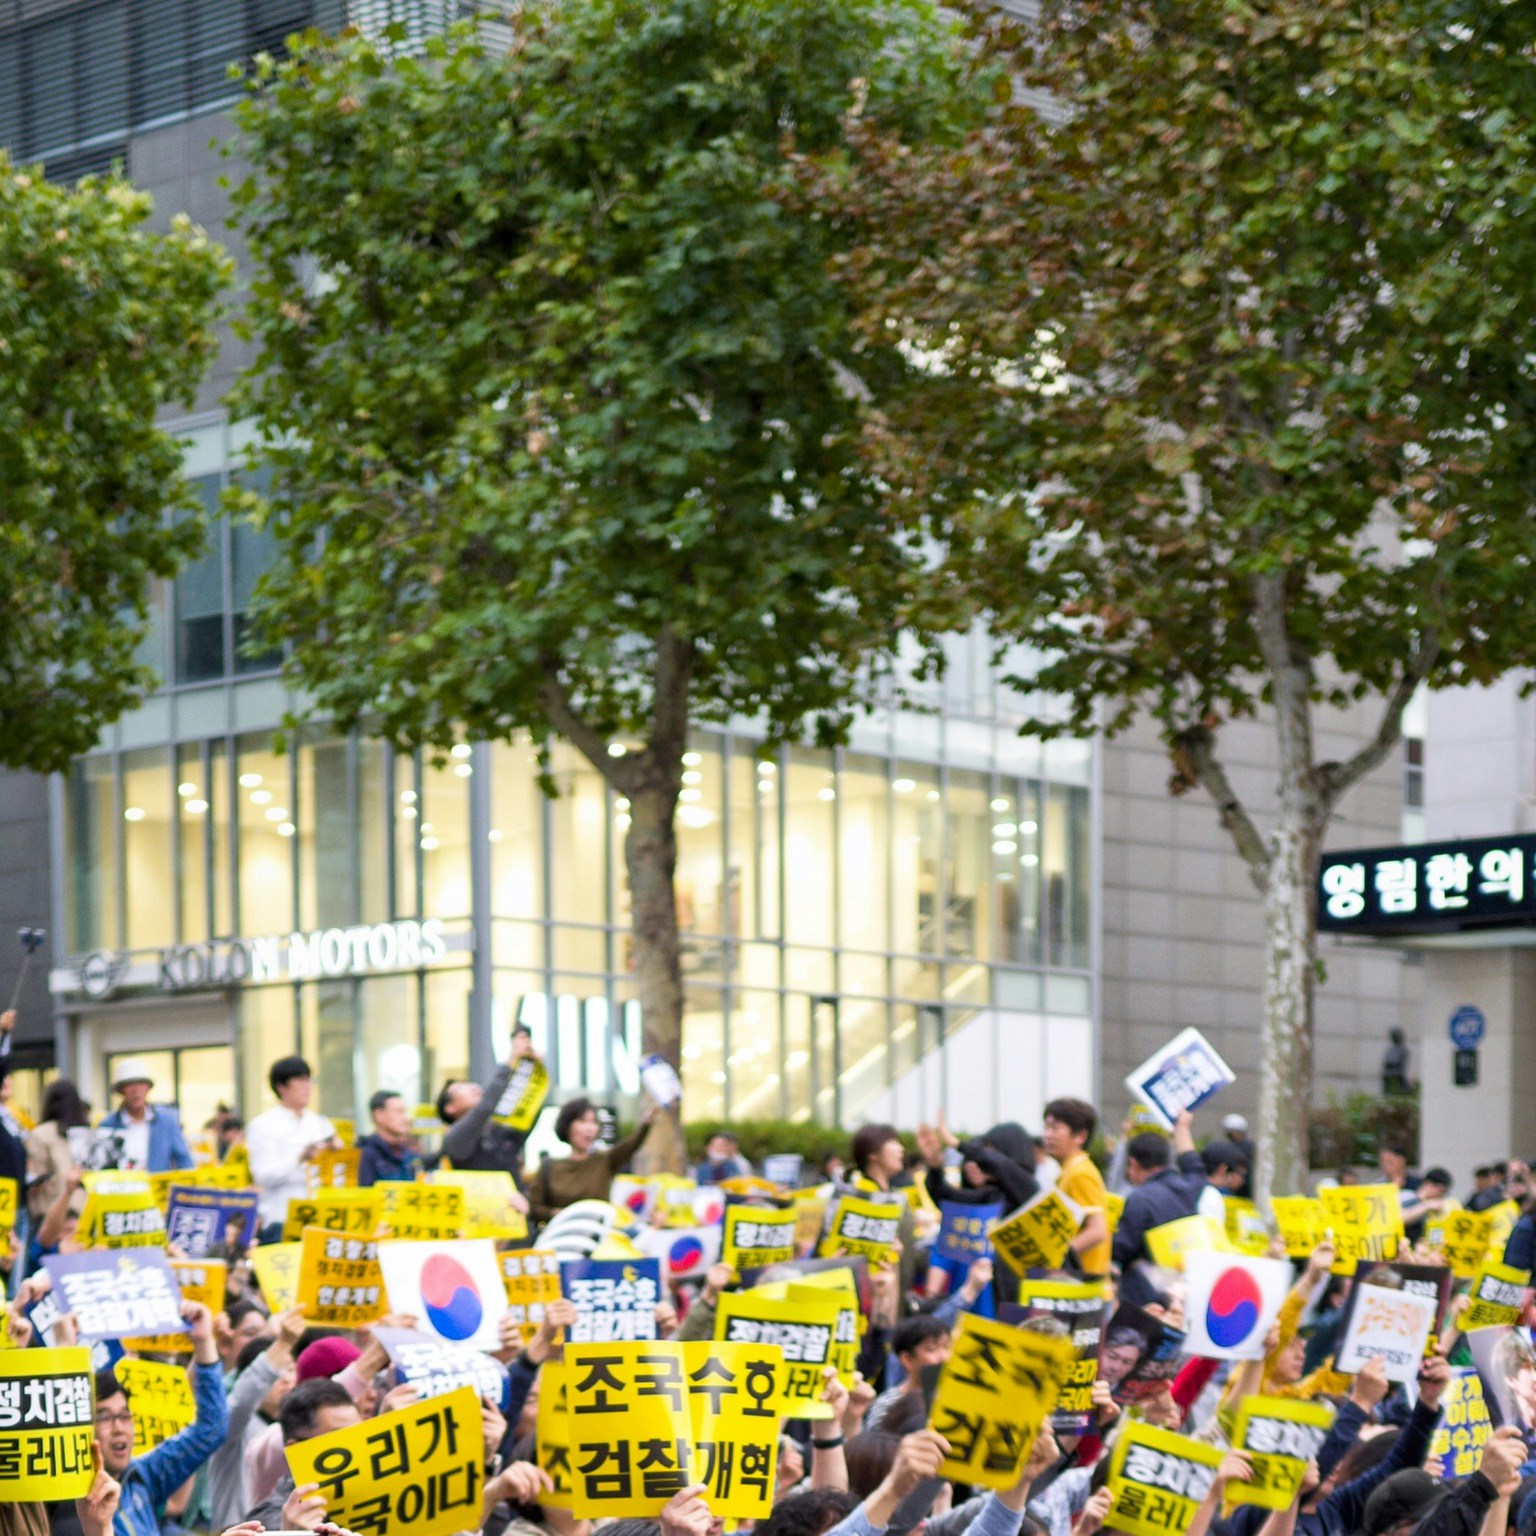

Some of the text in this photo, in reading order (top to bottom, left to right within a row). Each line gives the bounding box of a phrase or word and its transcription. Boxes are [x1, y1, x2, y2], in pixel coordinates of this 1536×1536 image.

[159, 917, 447, 991] KOLON MOTORS
[570, 1276, 658, 1313] 조국수호
[570, 1310, 657, 1341] 검찰개혁
[573, 1353, 777, 1419] 조국수호
[311, 1405, 460, 1501] 우리가
[576, 1436, 773, 1502] 검찰개혁
